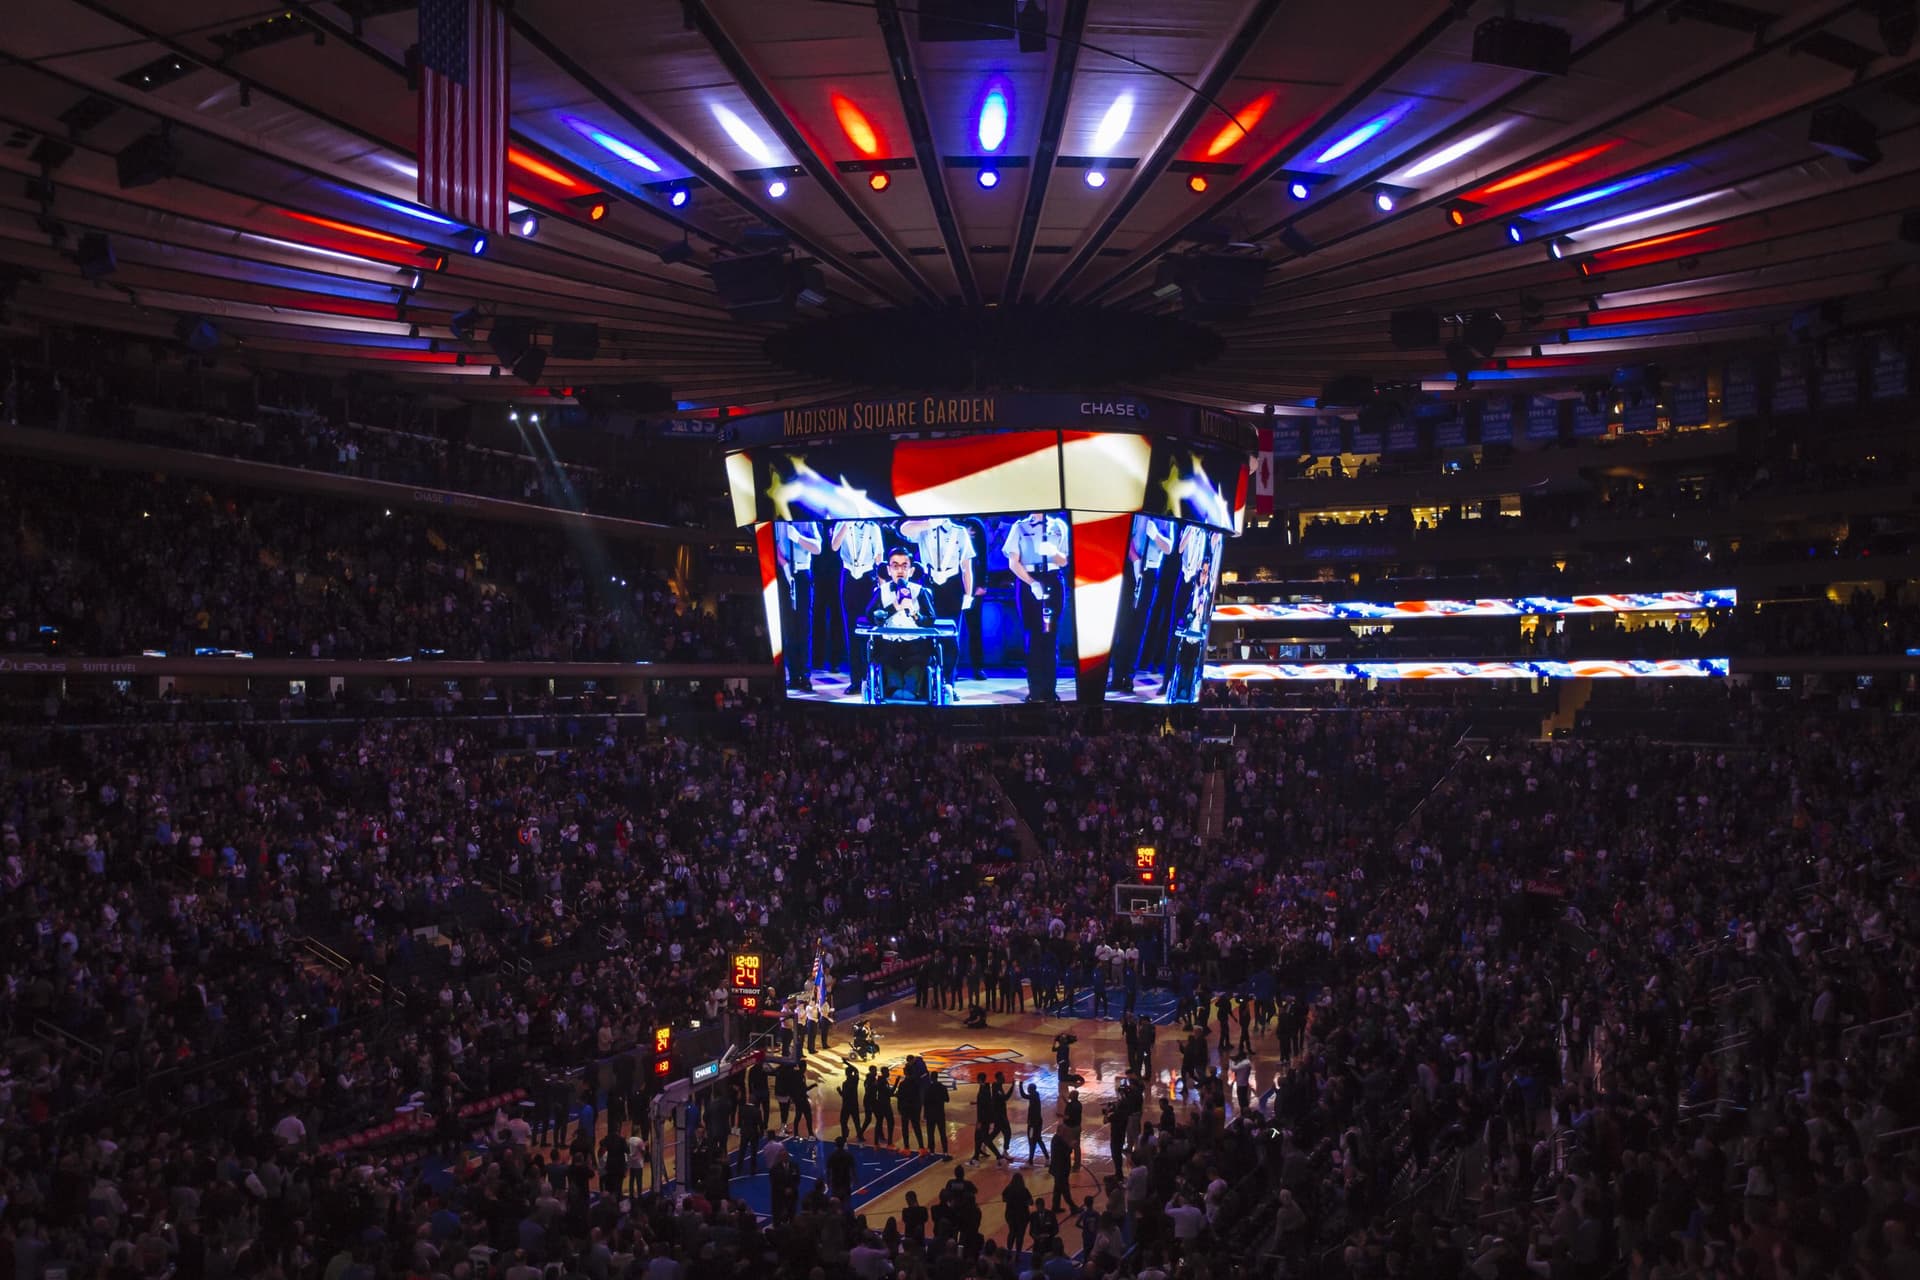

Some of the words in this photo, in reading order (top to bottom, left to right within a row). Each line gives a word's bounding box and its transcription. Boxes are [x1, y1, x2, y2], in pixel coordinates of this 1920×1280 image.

[1080, 402, 1136, 417] CHASE
[783, 407, 847, 436] MADISON
[853, 401, 918, 430] SQUARE
[923, 397, 995, 425] GARDEN
[13, 662, 66, 672] LEXUS
[82, 663, 108, 673] SUITE
[110, 663, 136, 673] LEVEL
[1137, 855, 1153, 867] 24
[736, 955, 759, 968] 12:00
[736, 967, 757, 985] 24
[657, 1037, 668, 1051] 24
